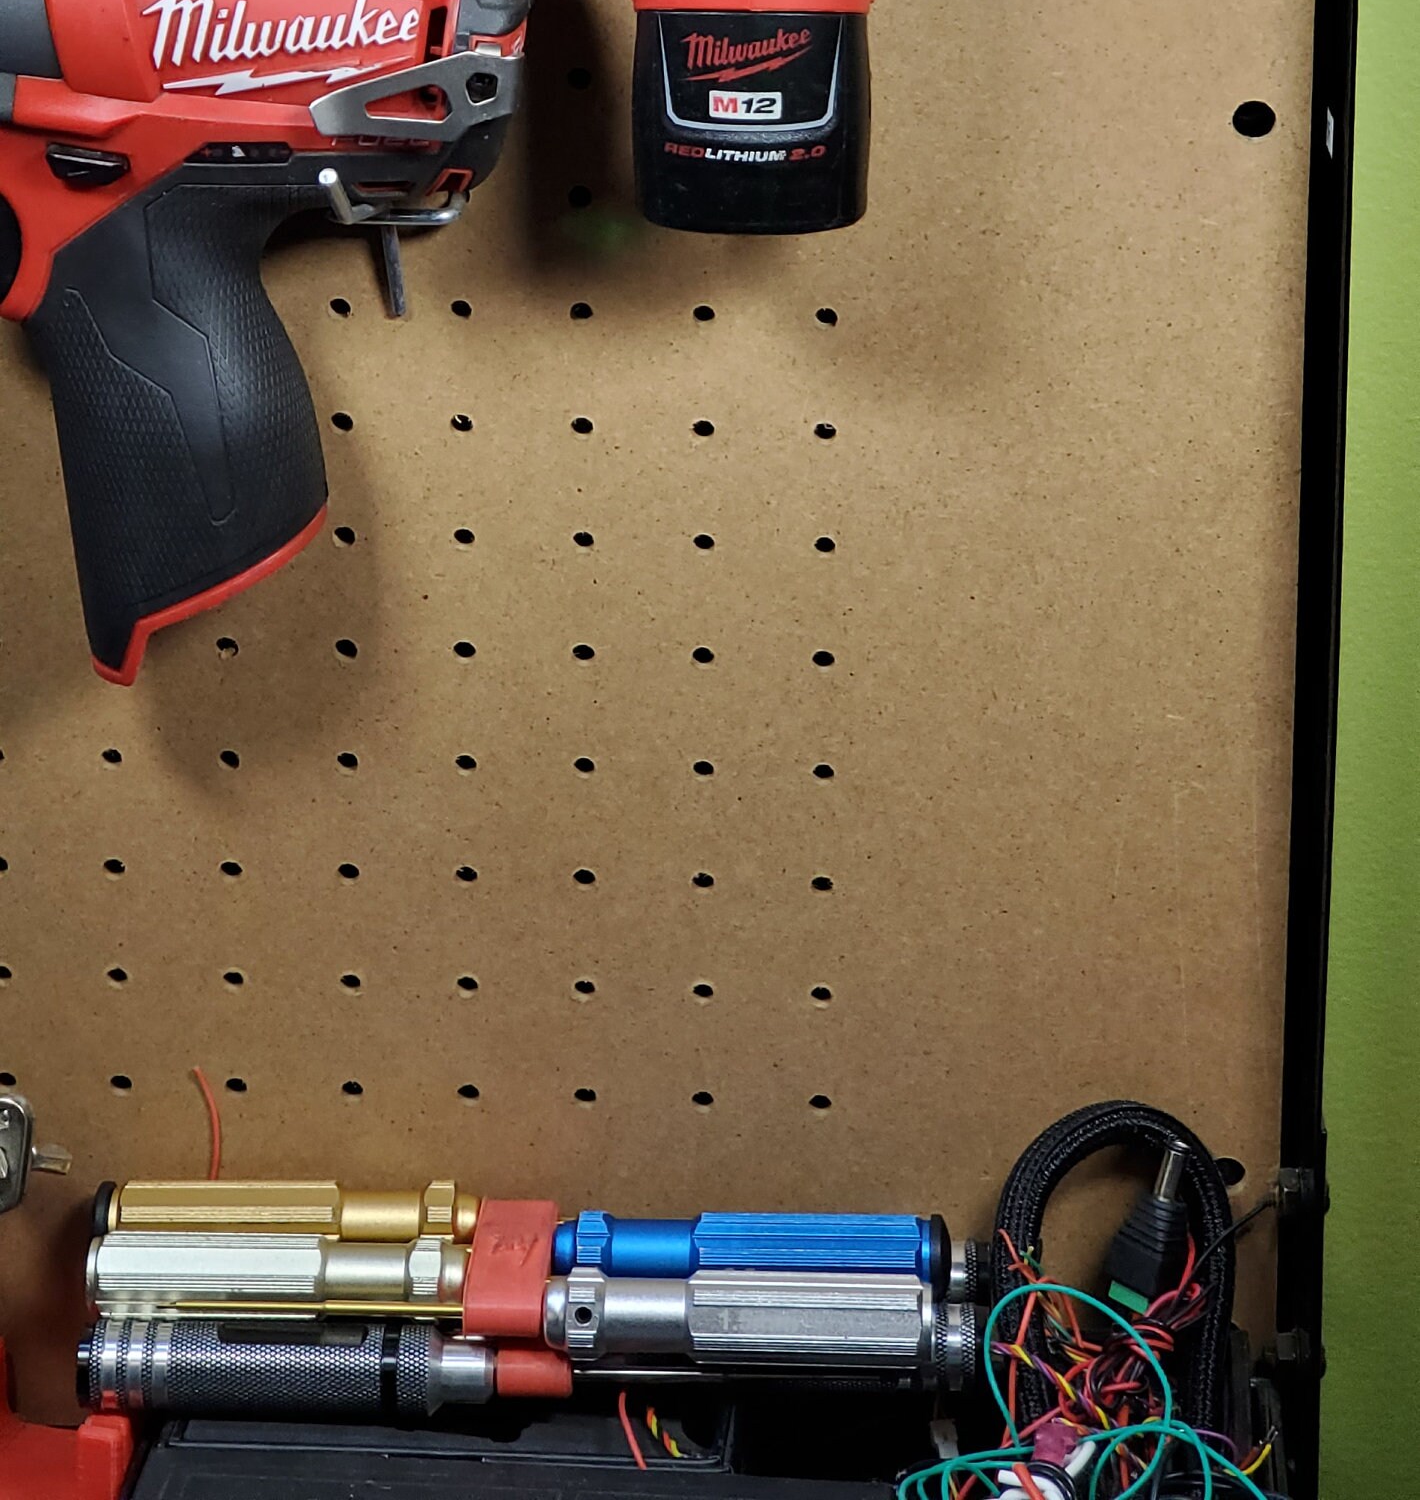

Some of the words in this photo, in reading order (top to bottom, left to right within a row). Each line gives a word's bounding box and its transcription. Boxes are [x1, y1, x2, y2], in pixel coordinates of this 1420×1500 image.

[680, 28, 811, 70] Milwaukee
[712, 96, 777, 114] M12
[788, 145, 826, 161] 2.0
